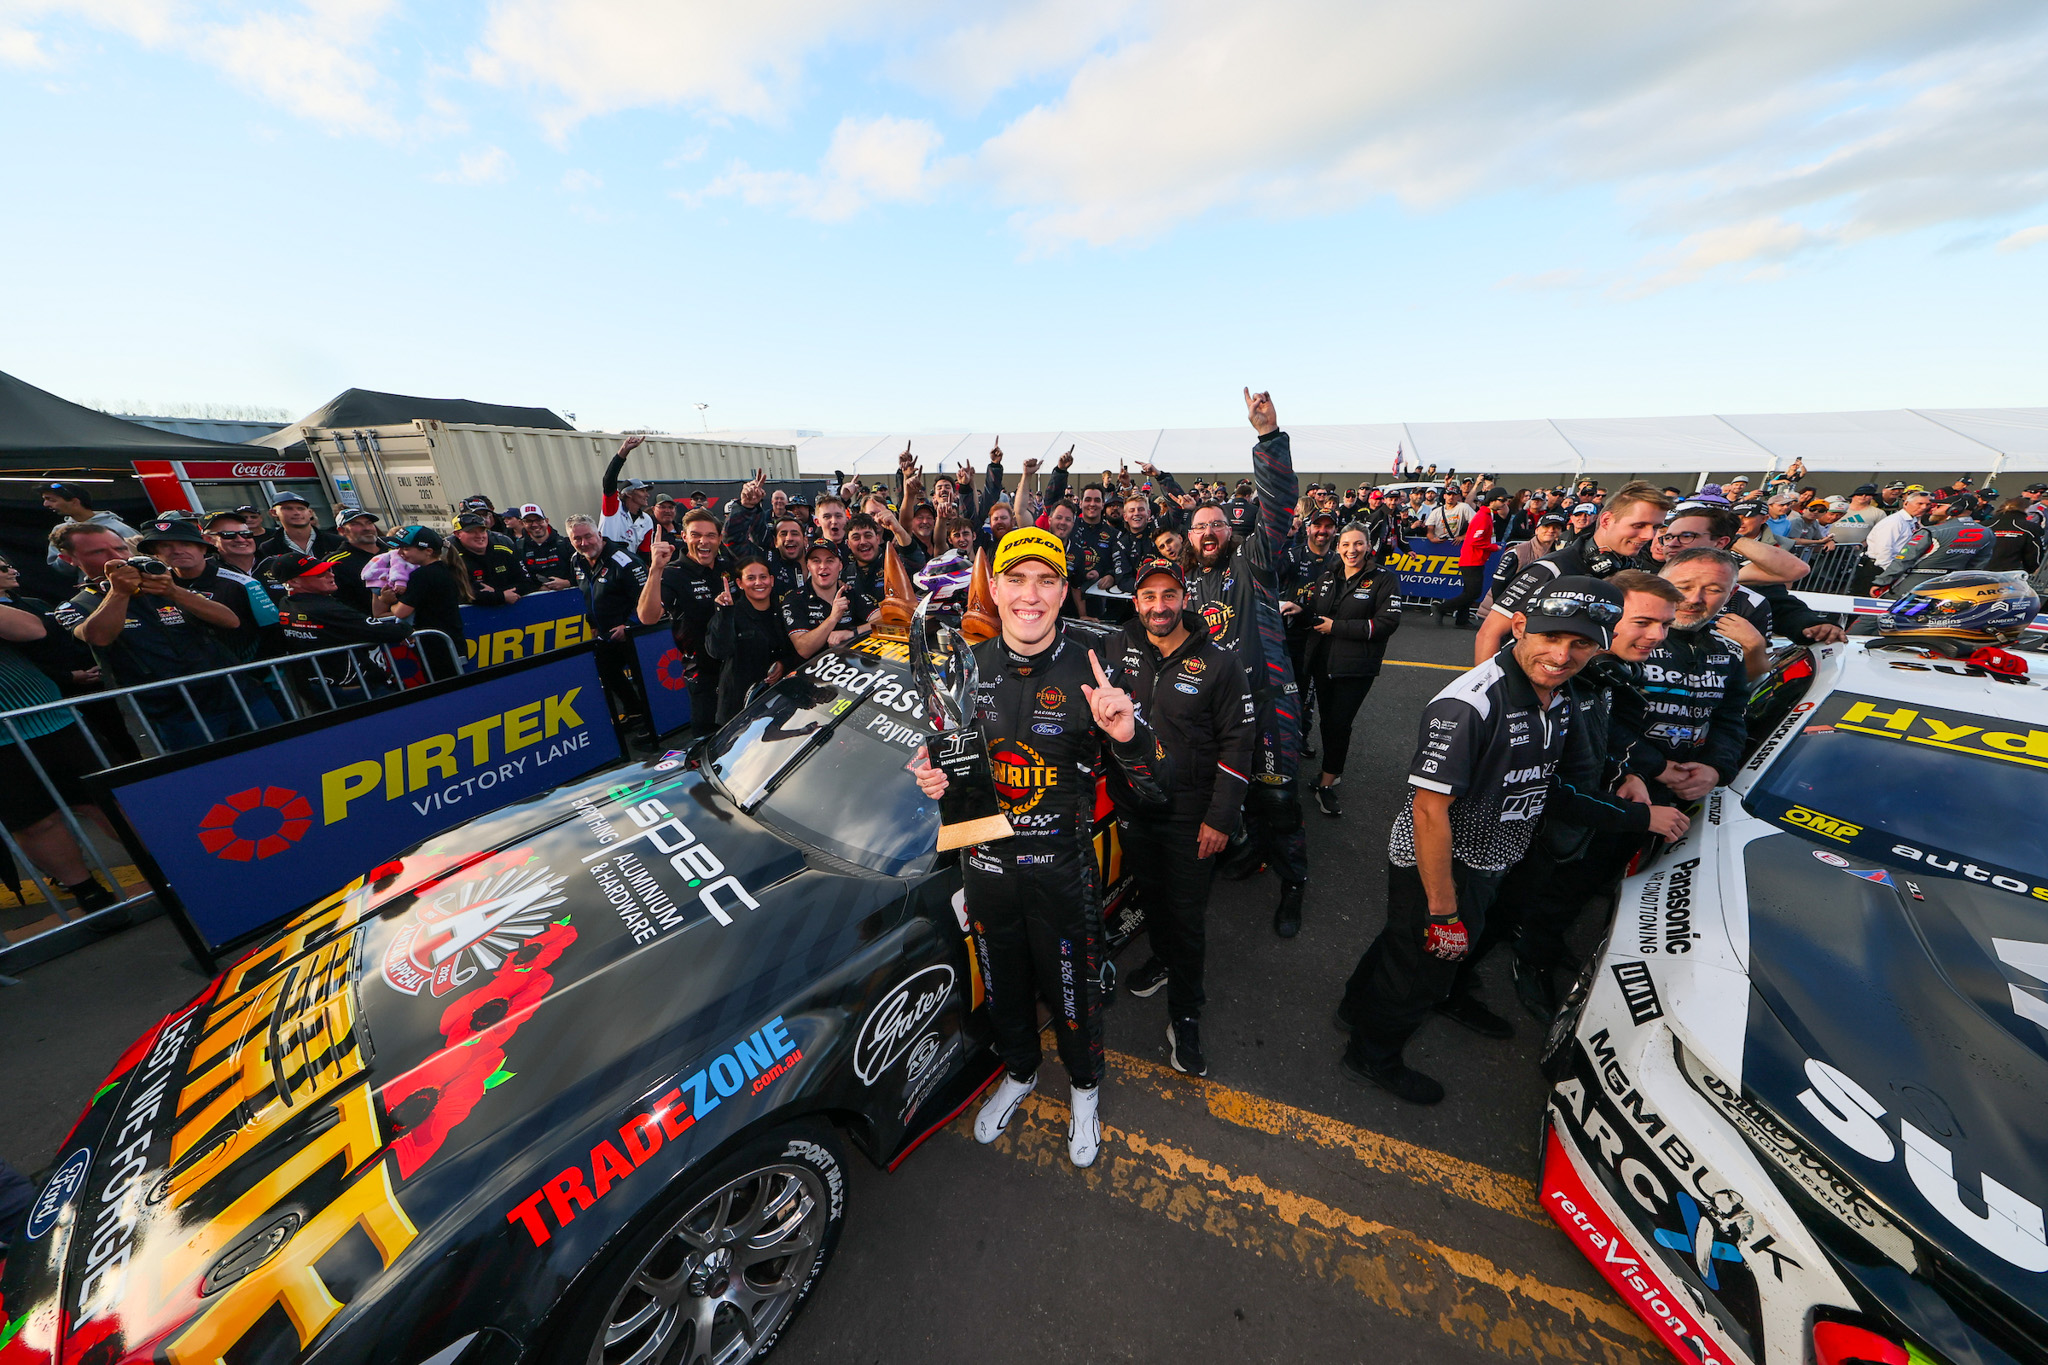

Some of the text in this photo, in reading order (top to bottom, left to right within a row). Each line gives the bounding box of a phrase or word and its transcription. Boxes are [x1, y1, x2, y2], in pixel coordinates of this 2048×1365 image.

[232, 462, 286, 477] Coca-Cola
[1835, 520, 1868, 529] adidas
[1002, 536, 1063, 554] DUNLOP
[1385, 553, 1462, 575] PIRTE
[1400, 574, 1464, 587] VICTORY LA
[1928, 618, 1962, 626] biggins
[1182, 658, 1207, 671] PENRITE
[1646, 664, 1728, 688] Bendix
[829, 698, 852, 716] 19
[1036, 692, 1067, 703] PENRITE
[866, 713, 923, 748] Payne
[972, 710, 999, 722] ROVE
[1034, 723, 1060, 735] Ford
[321, 687, 584, 826] PIRTEK
[1746, 712, 1804, 771] TRUCK ASSIST
[956, 753, 979, 762] RICHARDS
[990, 758, 1058, 787] NRITE
[1265, 751, 1274, 774] 1926
[412, 730, 591, 817] VICTORY LANE
[1708, 796, 1722, 826] DUNLOP
[1785, 809, 1860, 838] OMP
[1034, 854, 1055, 864] MATT
[590, 862, 657, 945] & HARDWARE
[612, 852, 684, 931] ALUMINIUM
[1665, 857, 1701, 955] Panasonic
[1639, 881, 1662, 954] CONDITIONING
[389, 928, 424, 989] ANZAC APPEAL
[437, 964, 451, 984] 2025
[1060, 960, 1076, 1020] SINCE 1926
[141, 1005, 198, 1083] LEST
[116, 1080, 171, 1147] WE
[506, 1015, 797, 1248] TRADEZONE
[1588, 1028, 1803, 1281] MGMBUK
[780, 1140, 844, 1222] SPORT MAXX
[1735, 1116, 1862, 1229] ENGINEERING
[30, 1155, 87, 1233] Ford
[1551, 1191, 1688, 1336] retraVision
